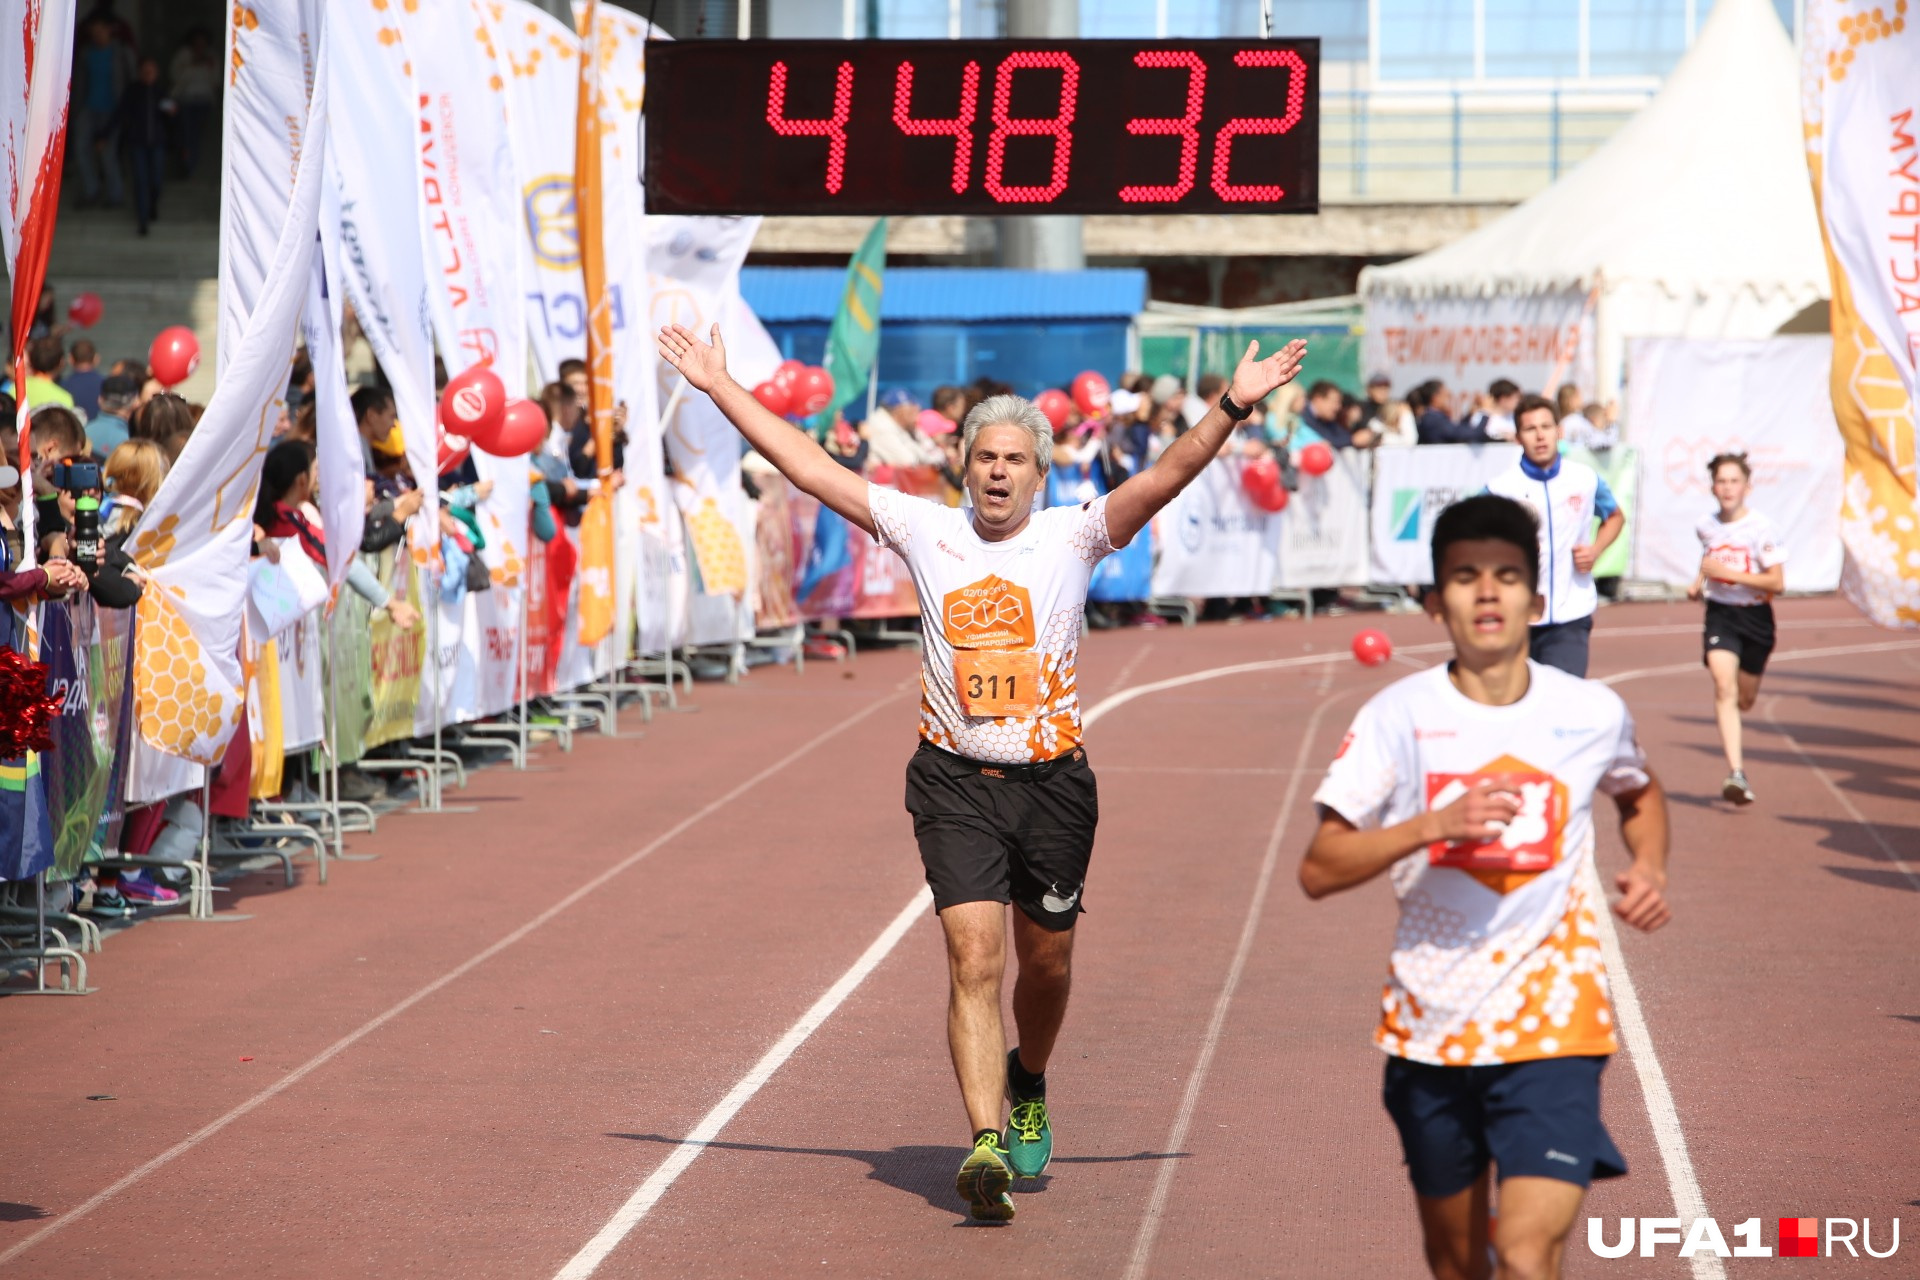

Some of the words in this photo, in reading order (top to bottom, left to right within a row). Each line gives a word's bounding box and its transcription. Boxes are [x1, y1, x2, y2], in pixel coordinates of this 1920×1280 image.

[766, 60, 855, 194] 4
[894, 51, 1080, 203] 48
[1118, 50, 1306, 203] 32
[965, 629, 1009, 641] УФИМСКИЙ
[967, 674, 1016, 700] 311
